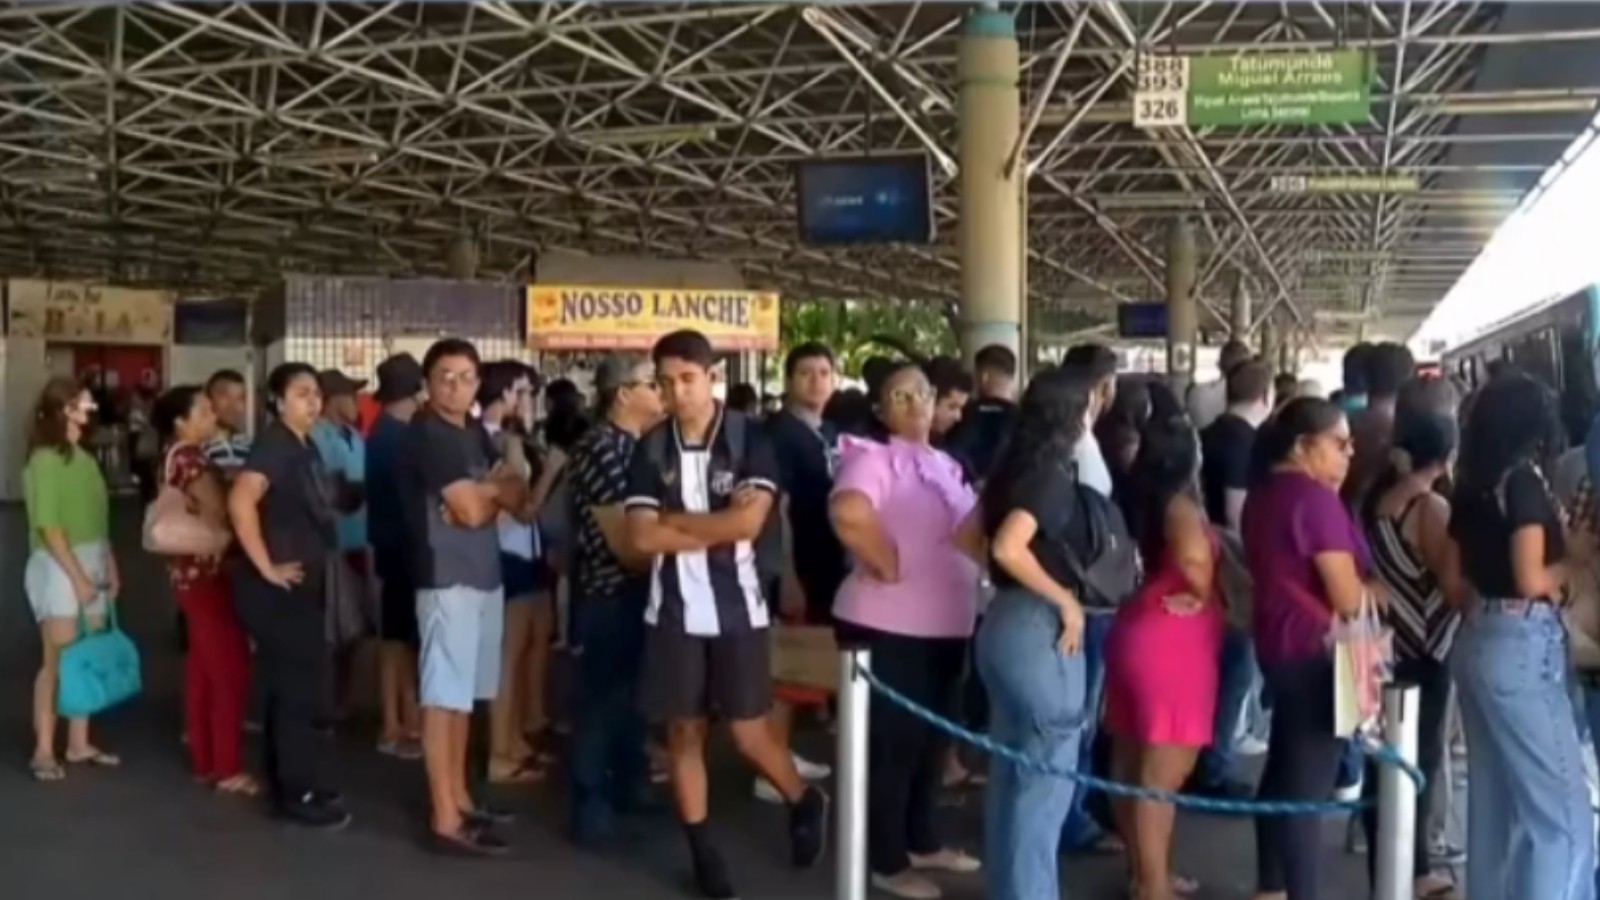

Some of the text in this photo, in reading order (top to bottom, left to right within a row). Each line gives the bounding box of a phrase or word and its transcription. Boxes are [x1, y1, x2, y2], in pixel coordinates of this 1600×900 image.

[1218, 70, 1343, 89] Miguel Arraes
[1139, 99, 1179, 119] 326
[560, 290, 750, 328] NOSSO LANCHE
